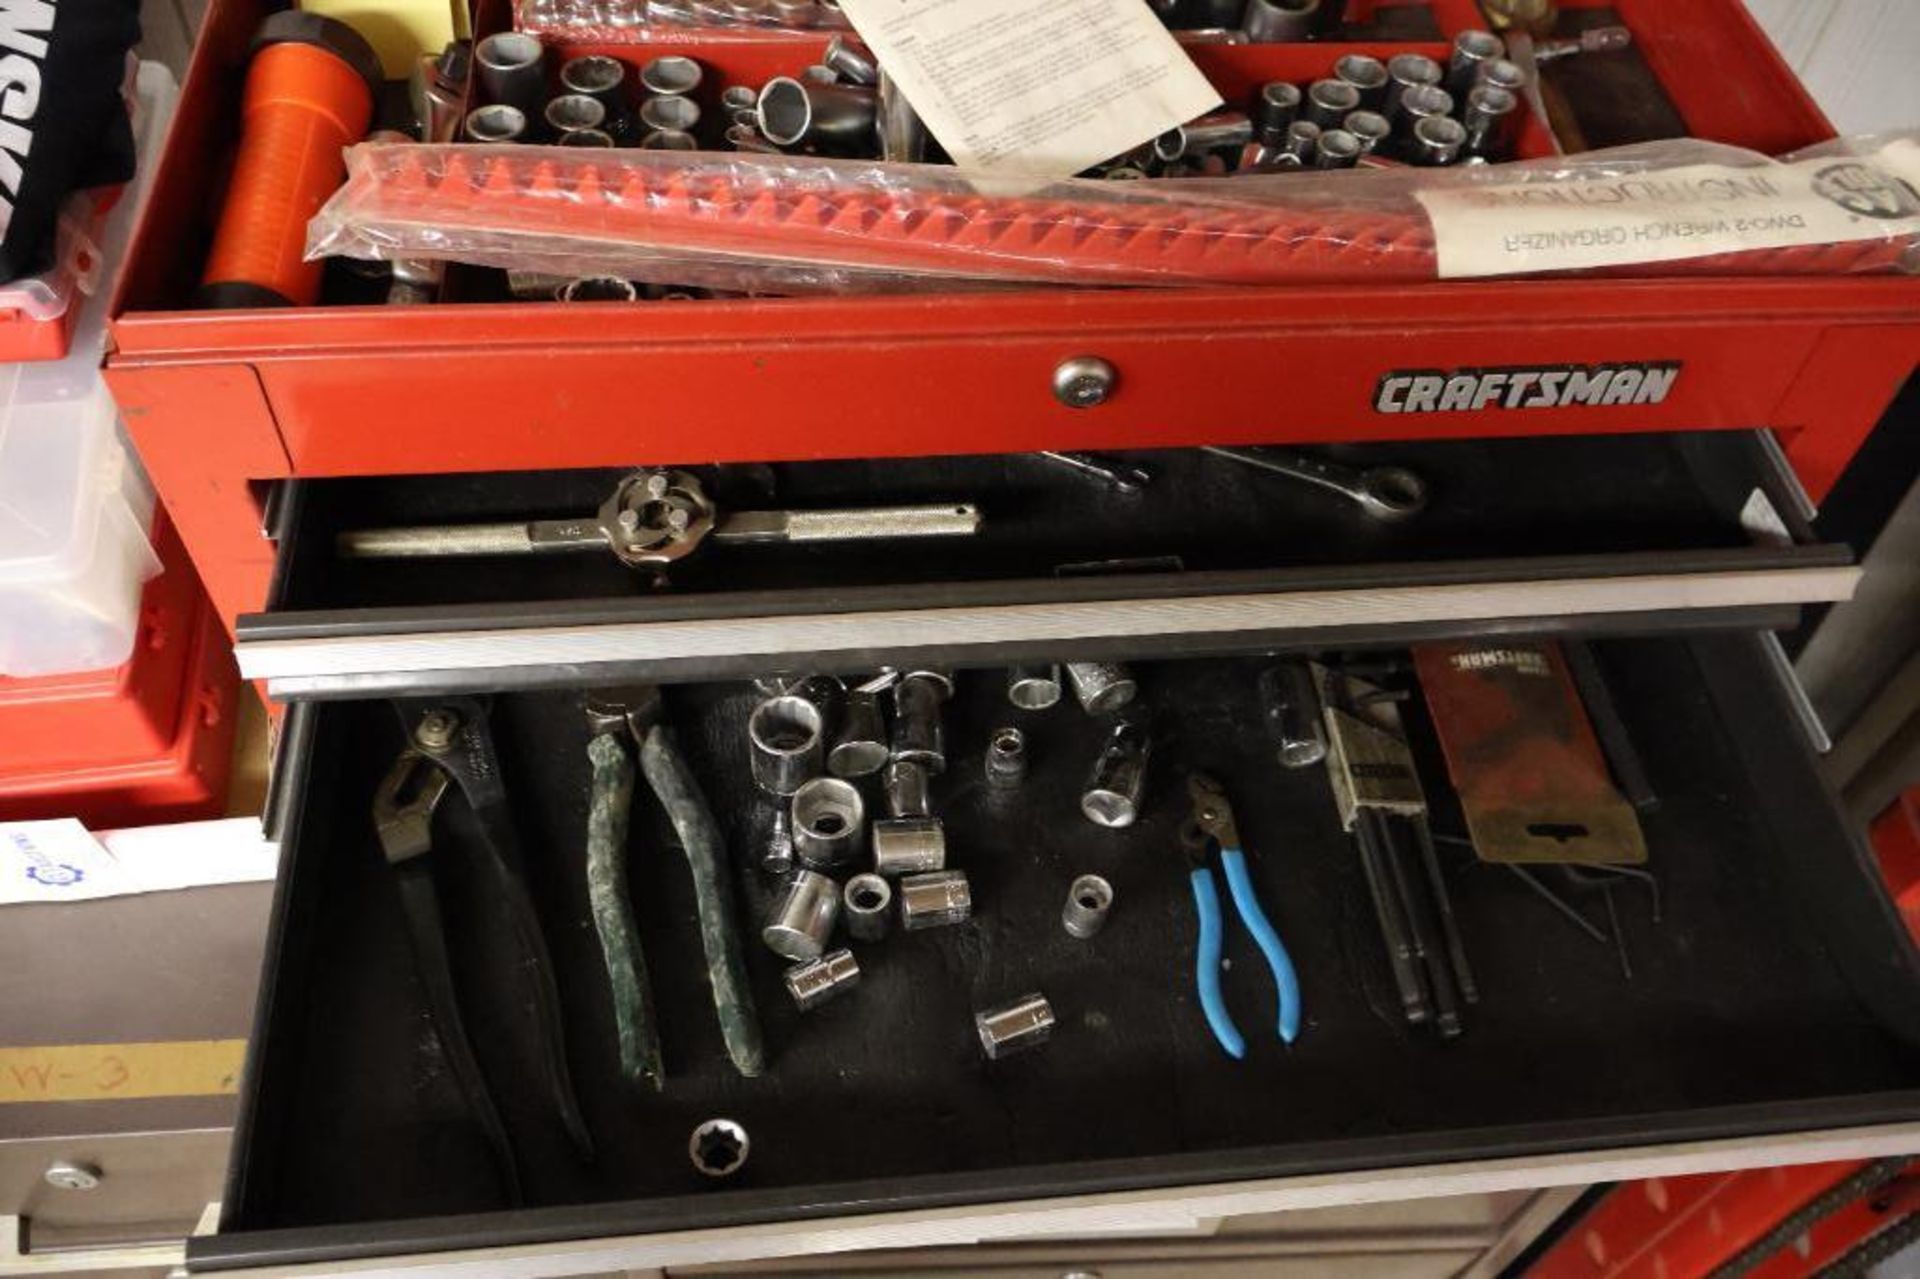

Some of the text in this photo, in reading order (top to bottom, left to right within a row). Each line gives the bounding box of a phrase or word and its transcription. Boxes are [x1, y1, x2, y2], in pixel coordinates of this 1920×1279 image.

[1504, 225, 1627, 252] ORGANIZER
[1634, 220, 1730, 241] WRENCH
[1376, 365, 1680, 413] CRAFTSMAN
